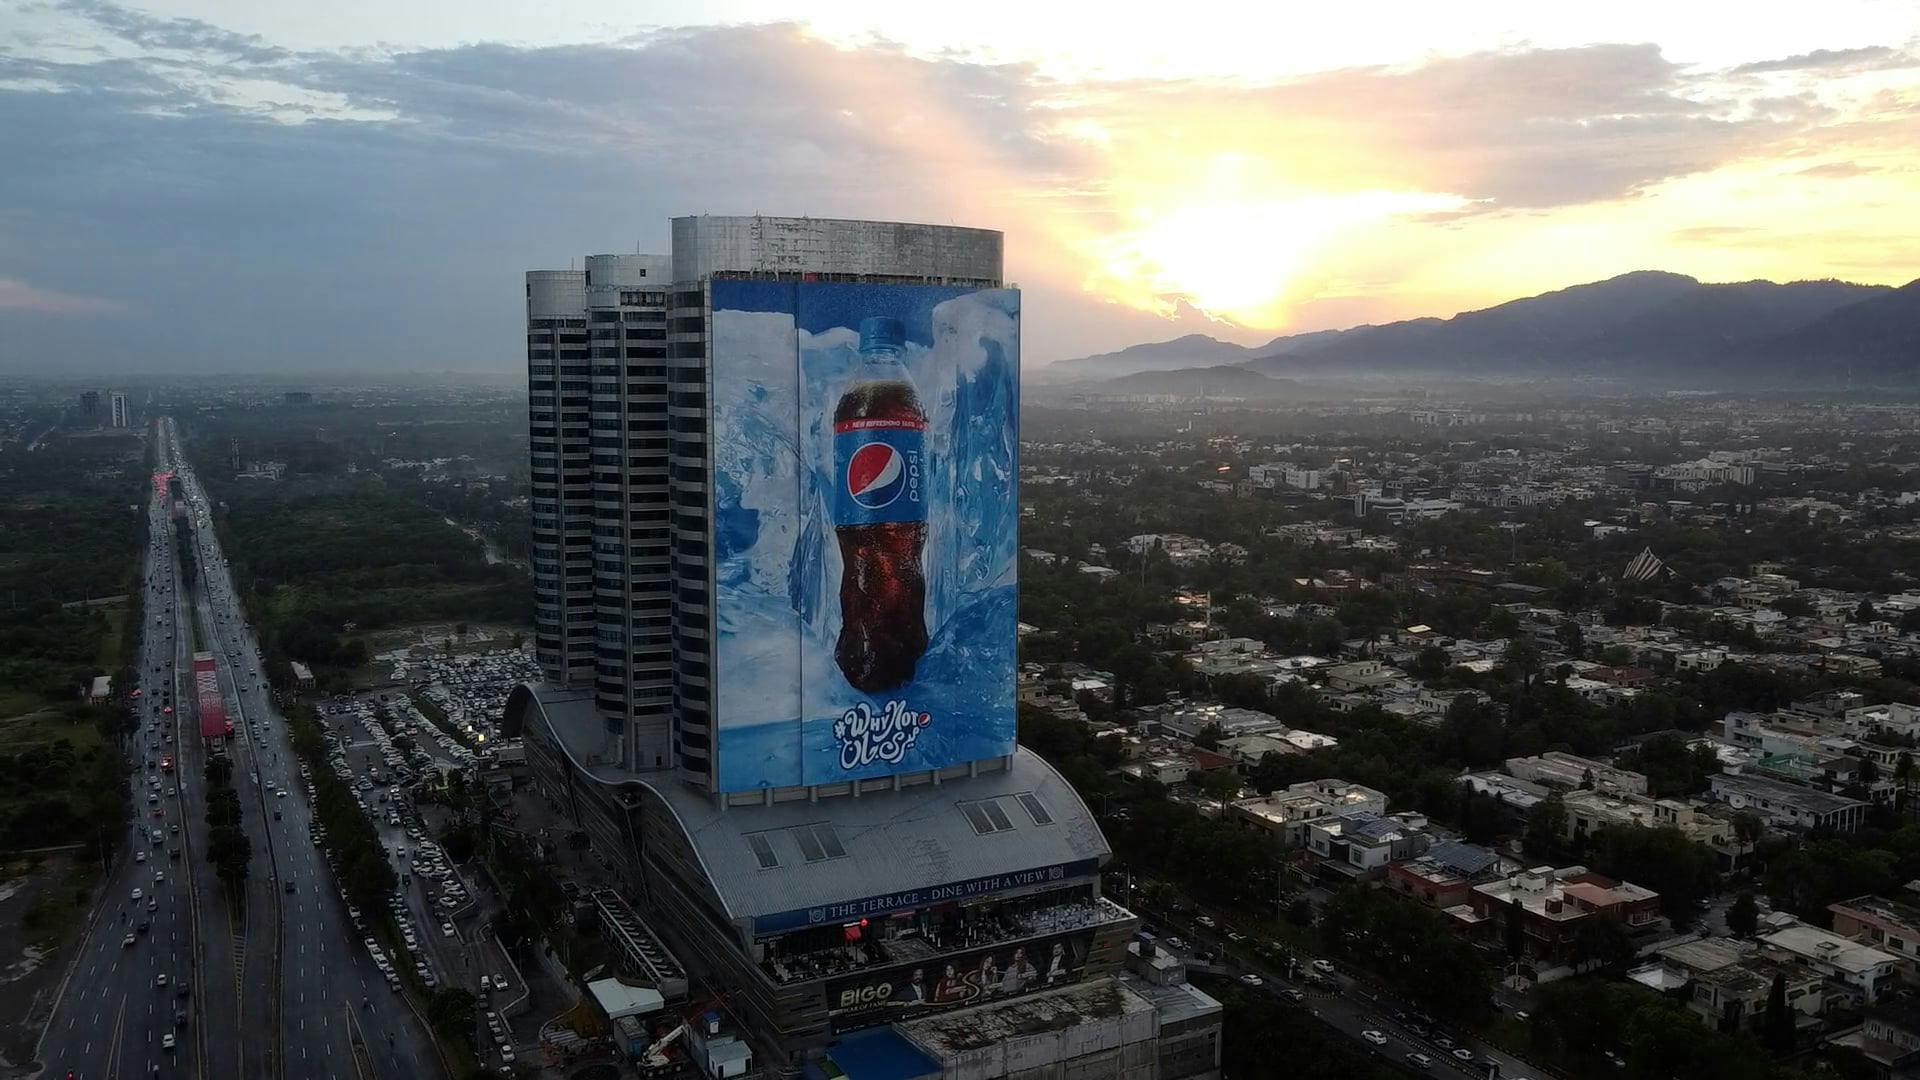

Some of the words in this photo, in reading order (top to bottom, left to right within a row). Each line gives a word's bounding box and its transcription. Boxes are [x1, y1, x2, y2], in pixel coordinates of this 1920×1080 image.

[907, 450, 920, 502] pepsi
[830, 903, 858, 918] THE
[862, 893, 919, 912] TERRACE
[931, 885, 963, 900] DINE
[966, 876, 1001, 894] WITH
[1003, 876, 1012, 886] A
[1015, 868, 1047, 885] VIEW
[840, 982, 892, 1007] BIGO
